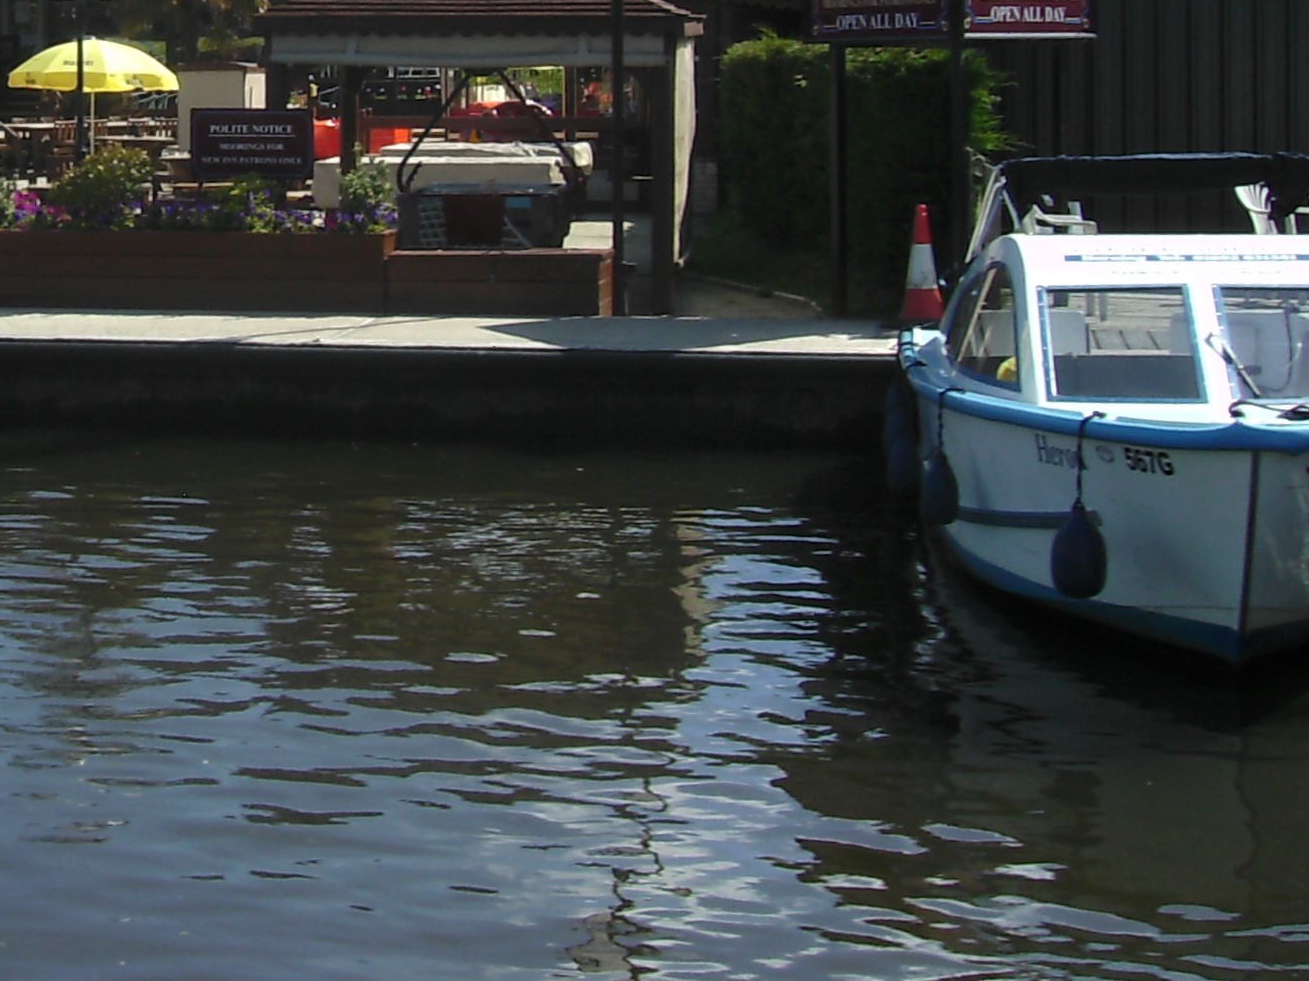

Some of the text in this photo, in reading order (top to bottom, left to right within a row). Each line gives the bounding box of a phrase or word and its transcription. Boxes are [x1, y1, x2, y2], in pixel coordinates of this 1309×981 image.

[836, 12, 919, 31] OPEN ALL DAY
[990, 5, 1067, 23] OPEN ALL DAY
[210, 124, 292, 133] POLITE NOTICE
